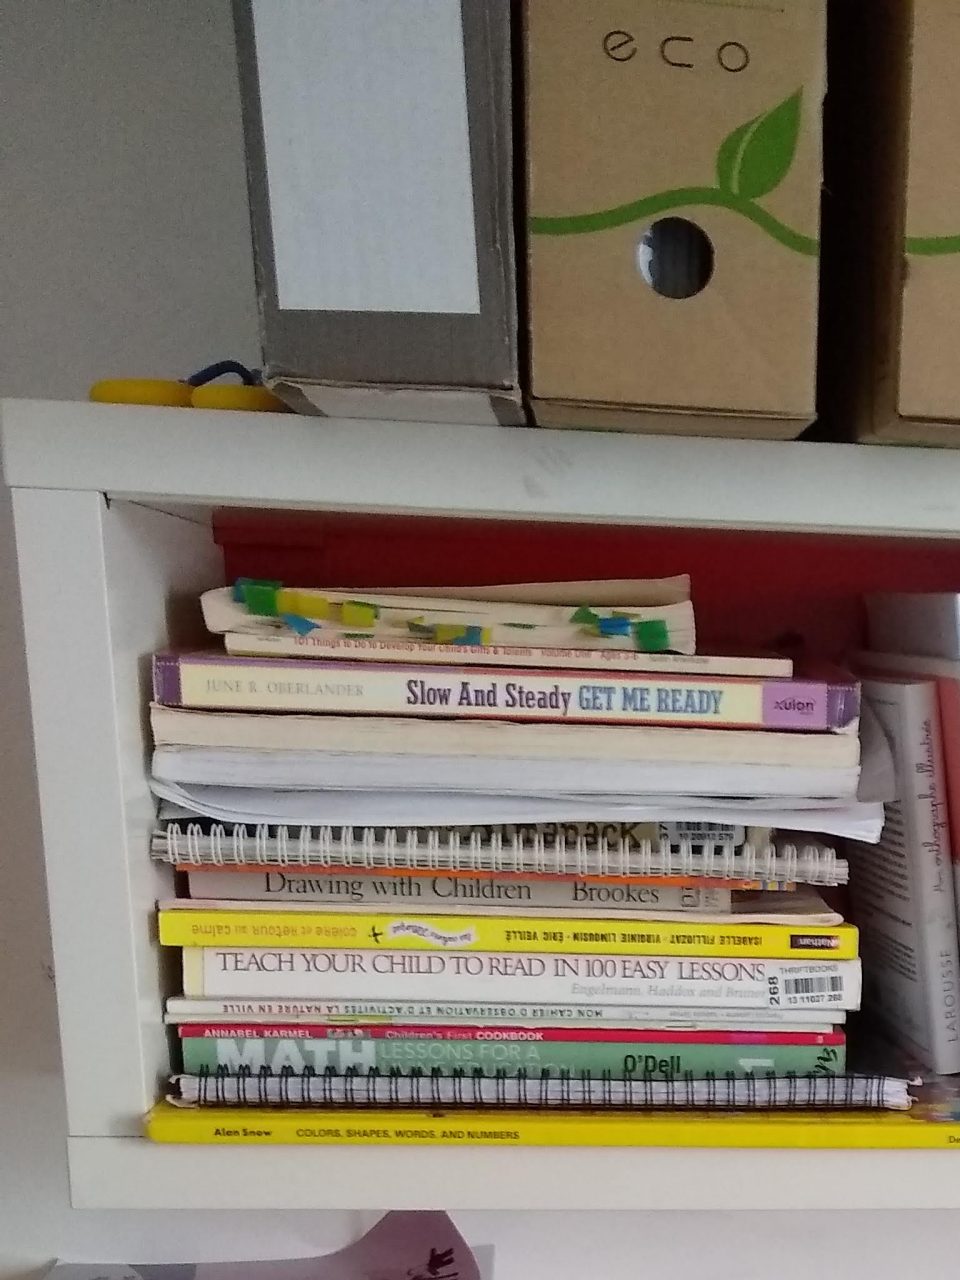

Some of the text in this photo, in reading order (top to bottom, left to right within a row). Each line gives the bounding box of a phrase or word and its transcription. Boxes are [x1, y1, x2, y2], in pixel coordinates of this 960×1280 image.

[603, 29, 750, 73] eco
[206, 678, 365, 698] JUNE OBERLANDER
[406, 679, 725, 716] Slow And Steady GET ME READY
[264, 871, 532, 901] Drawing with Children
[571, 880, 660, 904] Brookes
[572, 931, 763, 946] ISABELLE FILLIOZAT VIRGINIE LIMOUSIN
[216, 951, 767, 982] TEACH YOUR CHILD TO READ IN 100 EASY LESSONS
[767, 975, 781, 1006] 268
[937, 949, 960, 1044] LAROUSSE
[223, 1003, 254, 1014] VILLE
[259, 1003, 273, 1014] EN
[278, 1003, 321, 1014] NATURE
[326, 1004, 341, 1014] LA
[419, 1005, 432, 1016] ET
[532, 1008, 574, 1019] CAHIER
[577, 1008, 603, 1019] MON
[203, 1028, 312, 1039] ANNABEL KARMEL
[476, 1031, 545, 1042] COOKBOOK
[216, 1038, 376, 1074] MATH
[380, 1041, 542, 1061] LESSONS FOR A
[623, 1054, 681, 1075] O'Dell
[213, 1128, 273, 1138] Alan Snow
[441, 1130, 521, 1141] AND NUMBERS
